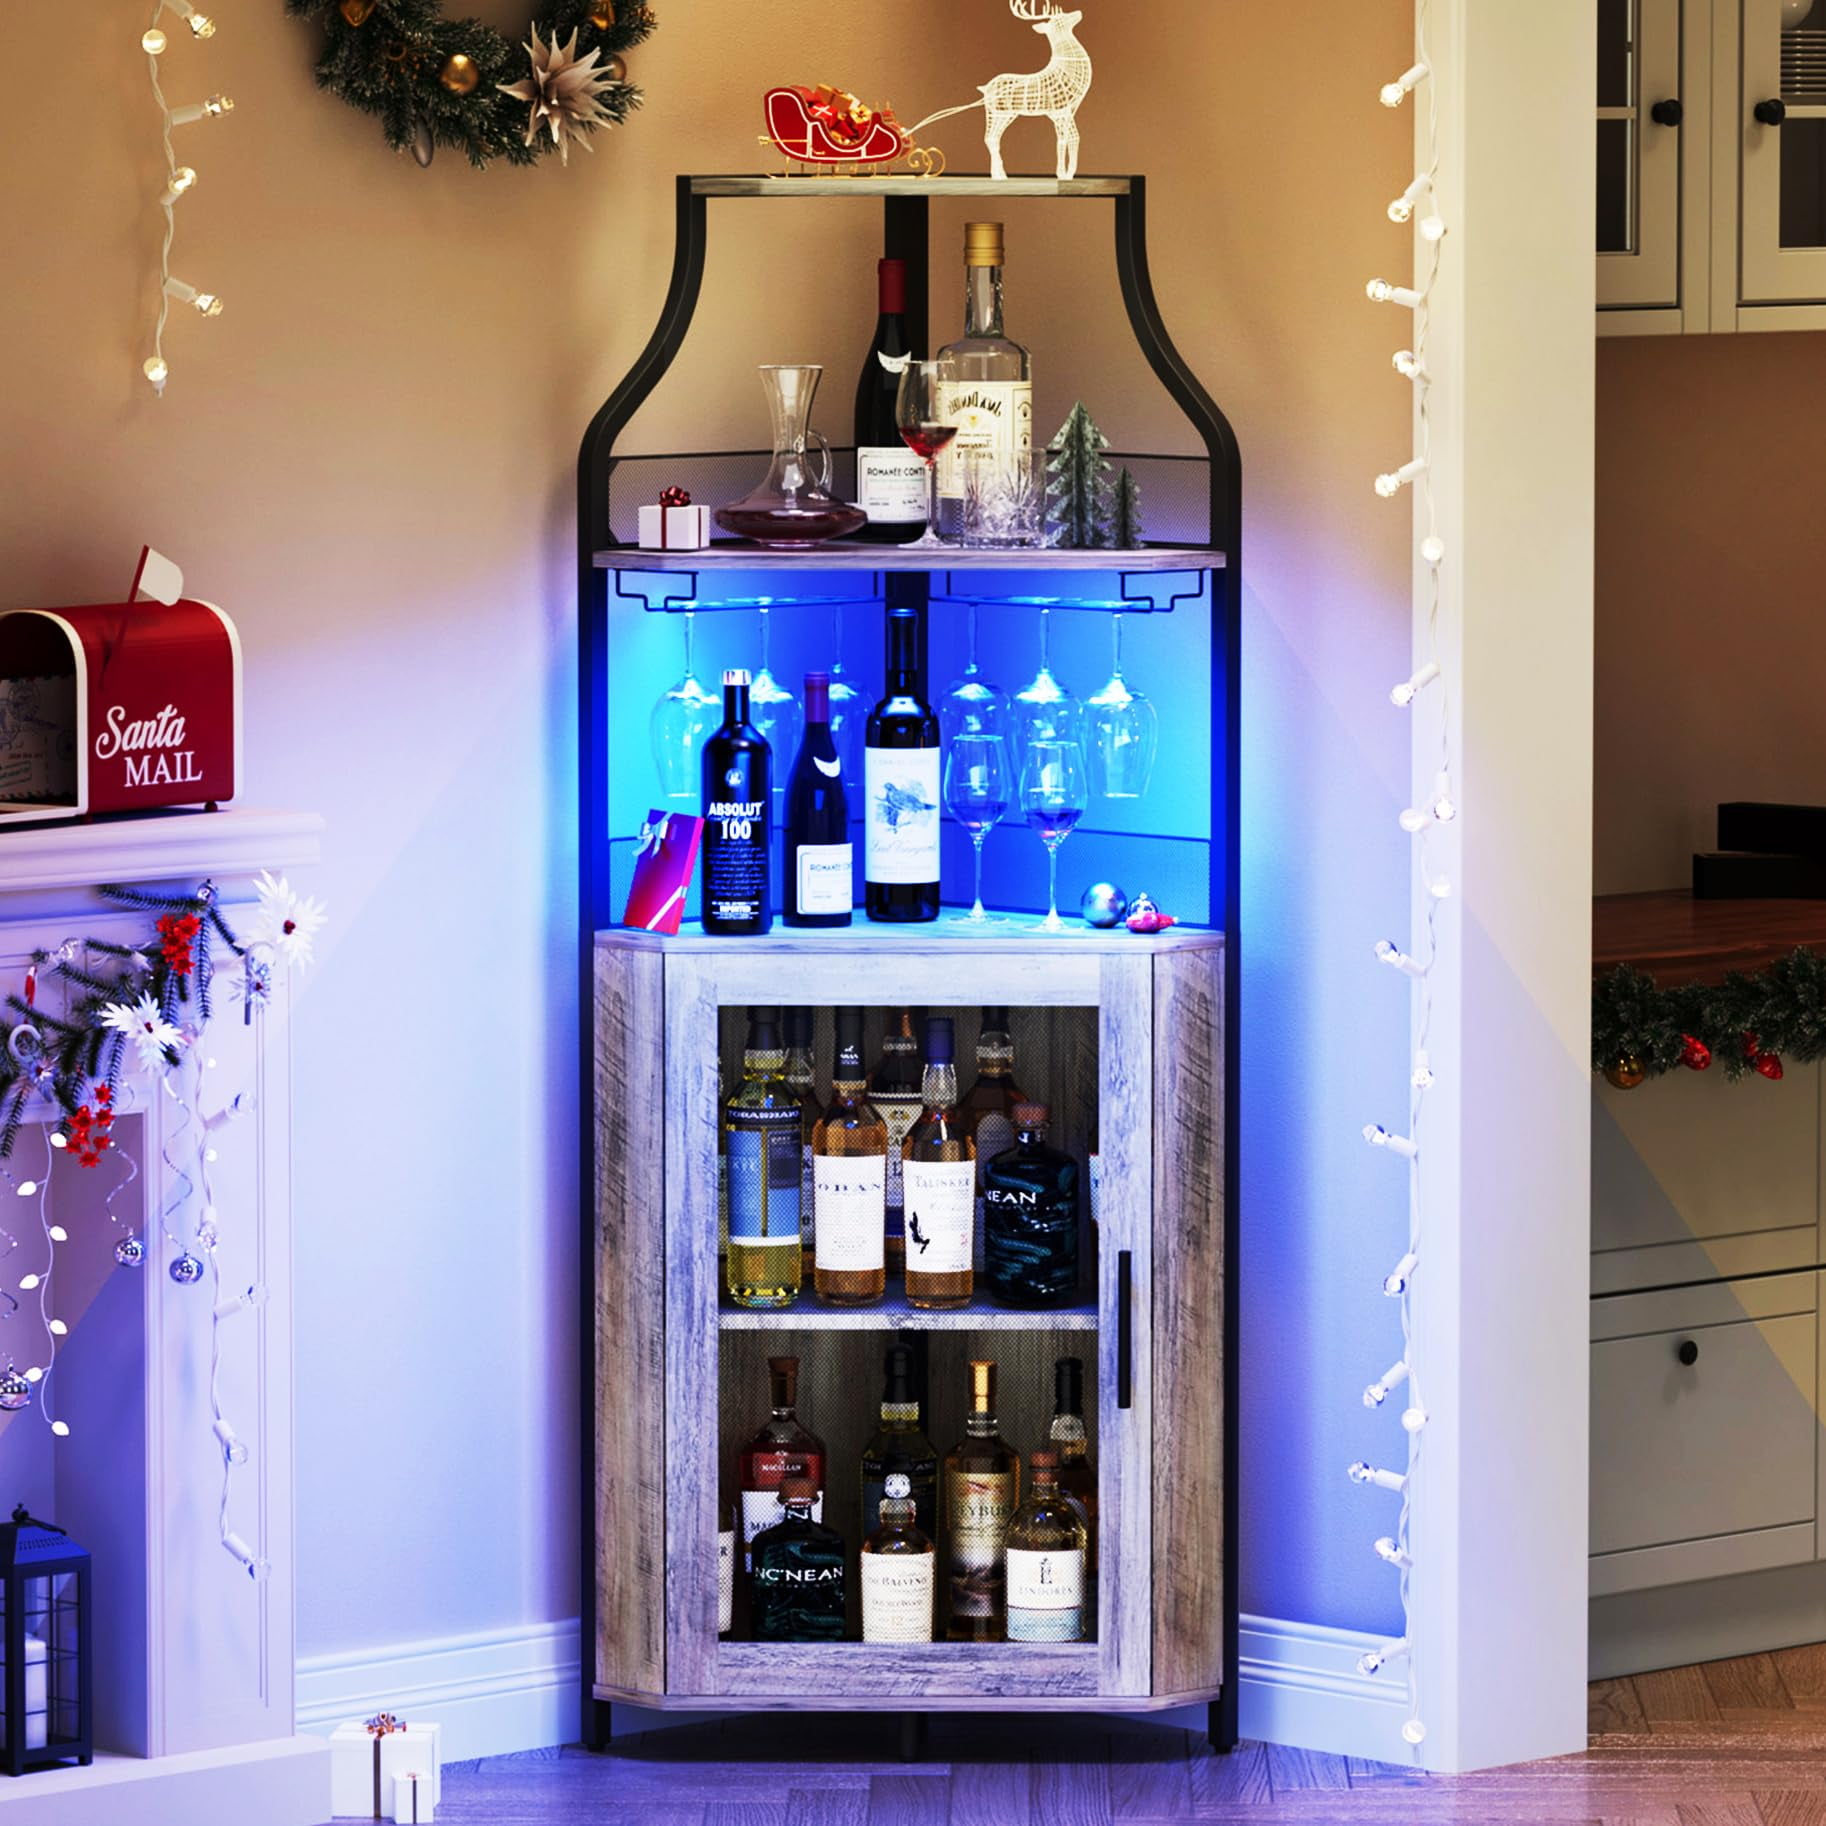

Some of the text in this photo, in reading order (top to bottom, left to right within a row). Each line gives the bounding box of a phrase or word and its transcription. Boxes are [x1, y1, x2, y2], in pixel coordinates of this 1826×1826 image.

[95, 704, 187, 760] Santa
[123, 751, 203, 788] MAIL
[707, 802, 763, 817] ABSOLUT
[721, 820, 752, 840] 100
[817, 1182, 882, 1194] OBAN
